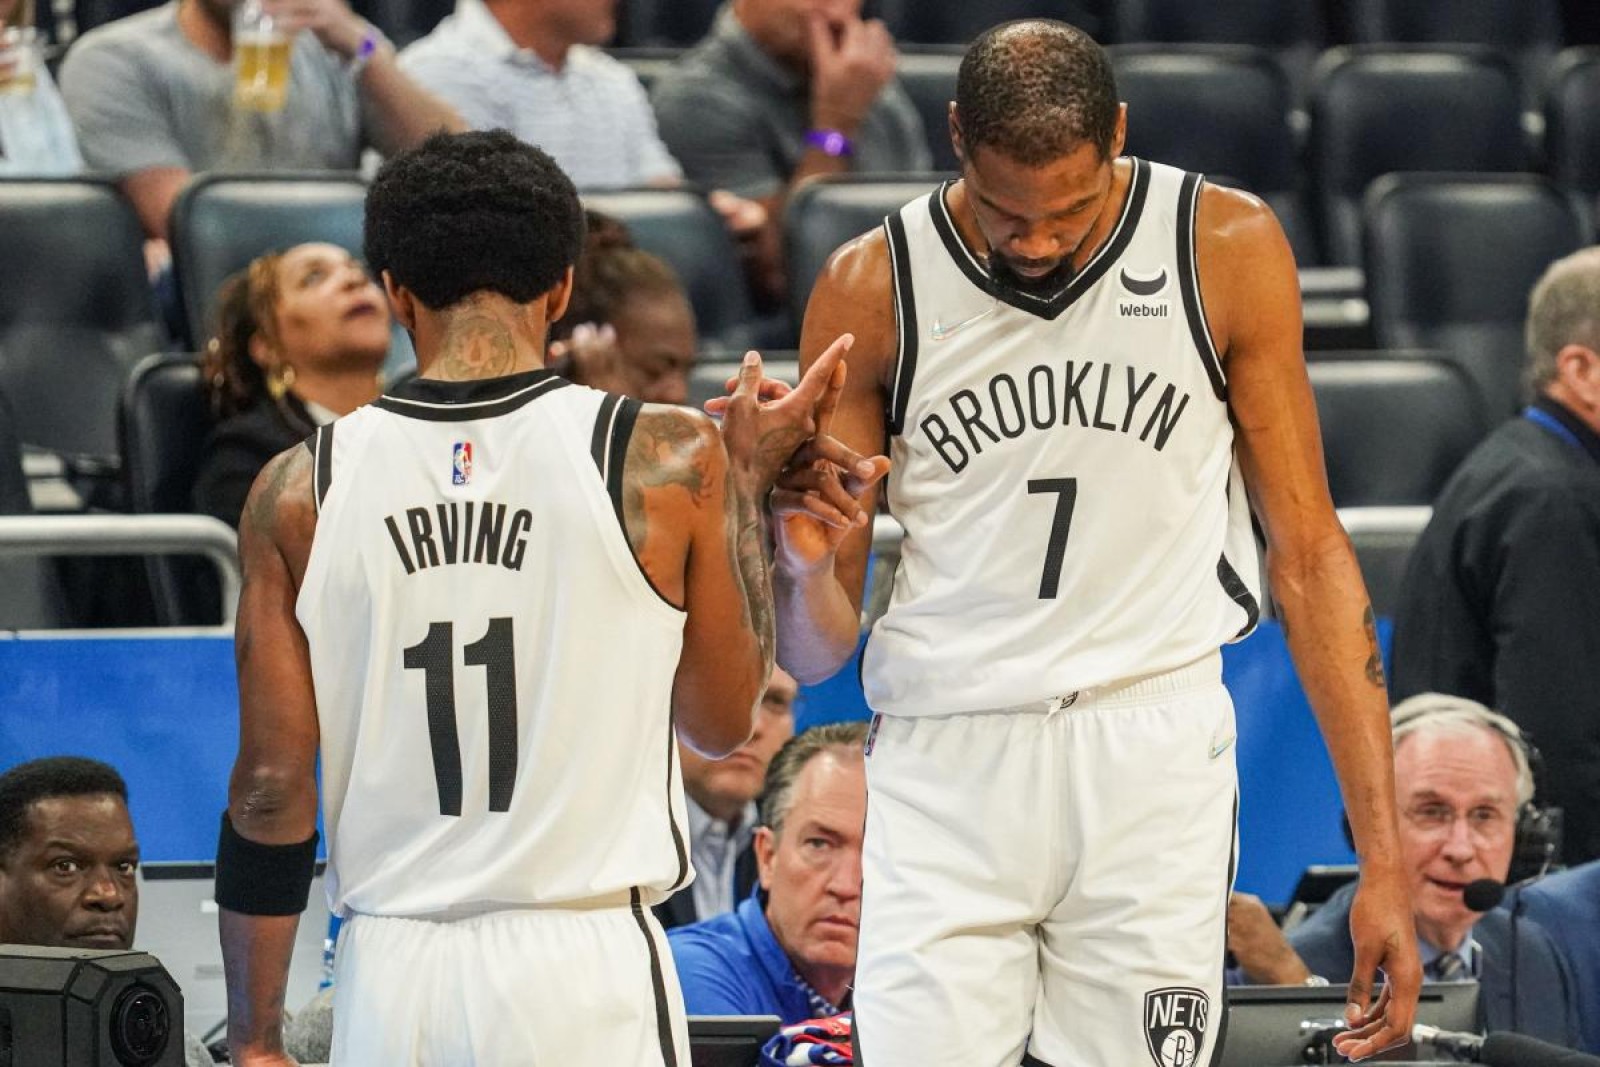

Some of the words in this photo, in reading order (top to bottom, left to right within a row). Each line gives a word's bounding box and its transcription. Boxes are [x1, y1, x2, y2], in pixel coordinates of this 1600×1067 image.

[1119, 303, 1168, 317] Webull
[920, 360, 1190, 474] BROOKLYN
[384, 501, 532, 575] IRVING
[1027, 477, 1077, 600] 7
[403, 616, 518, 816] 11
[1149, 994, 1208, 1033] NETS
[1174, 1035, 1186, 1067] B
